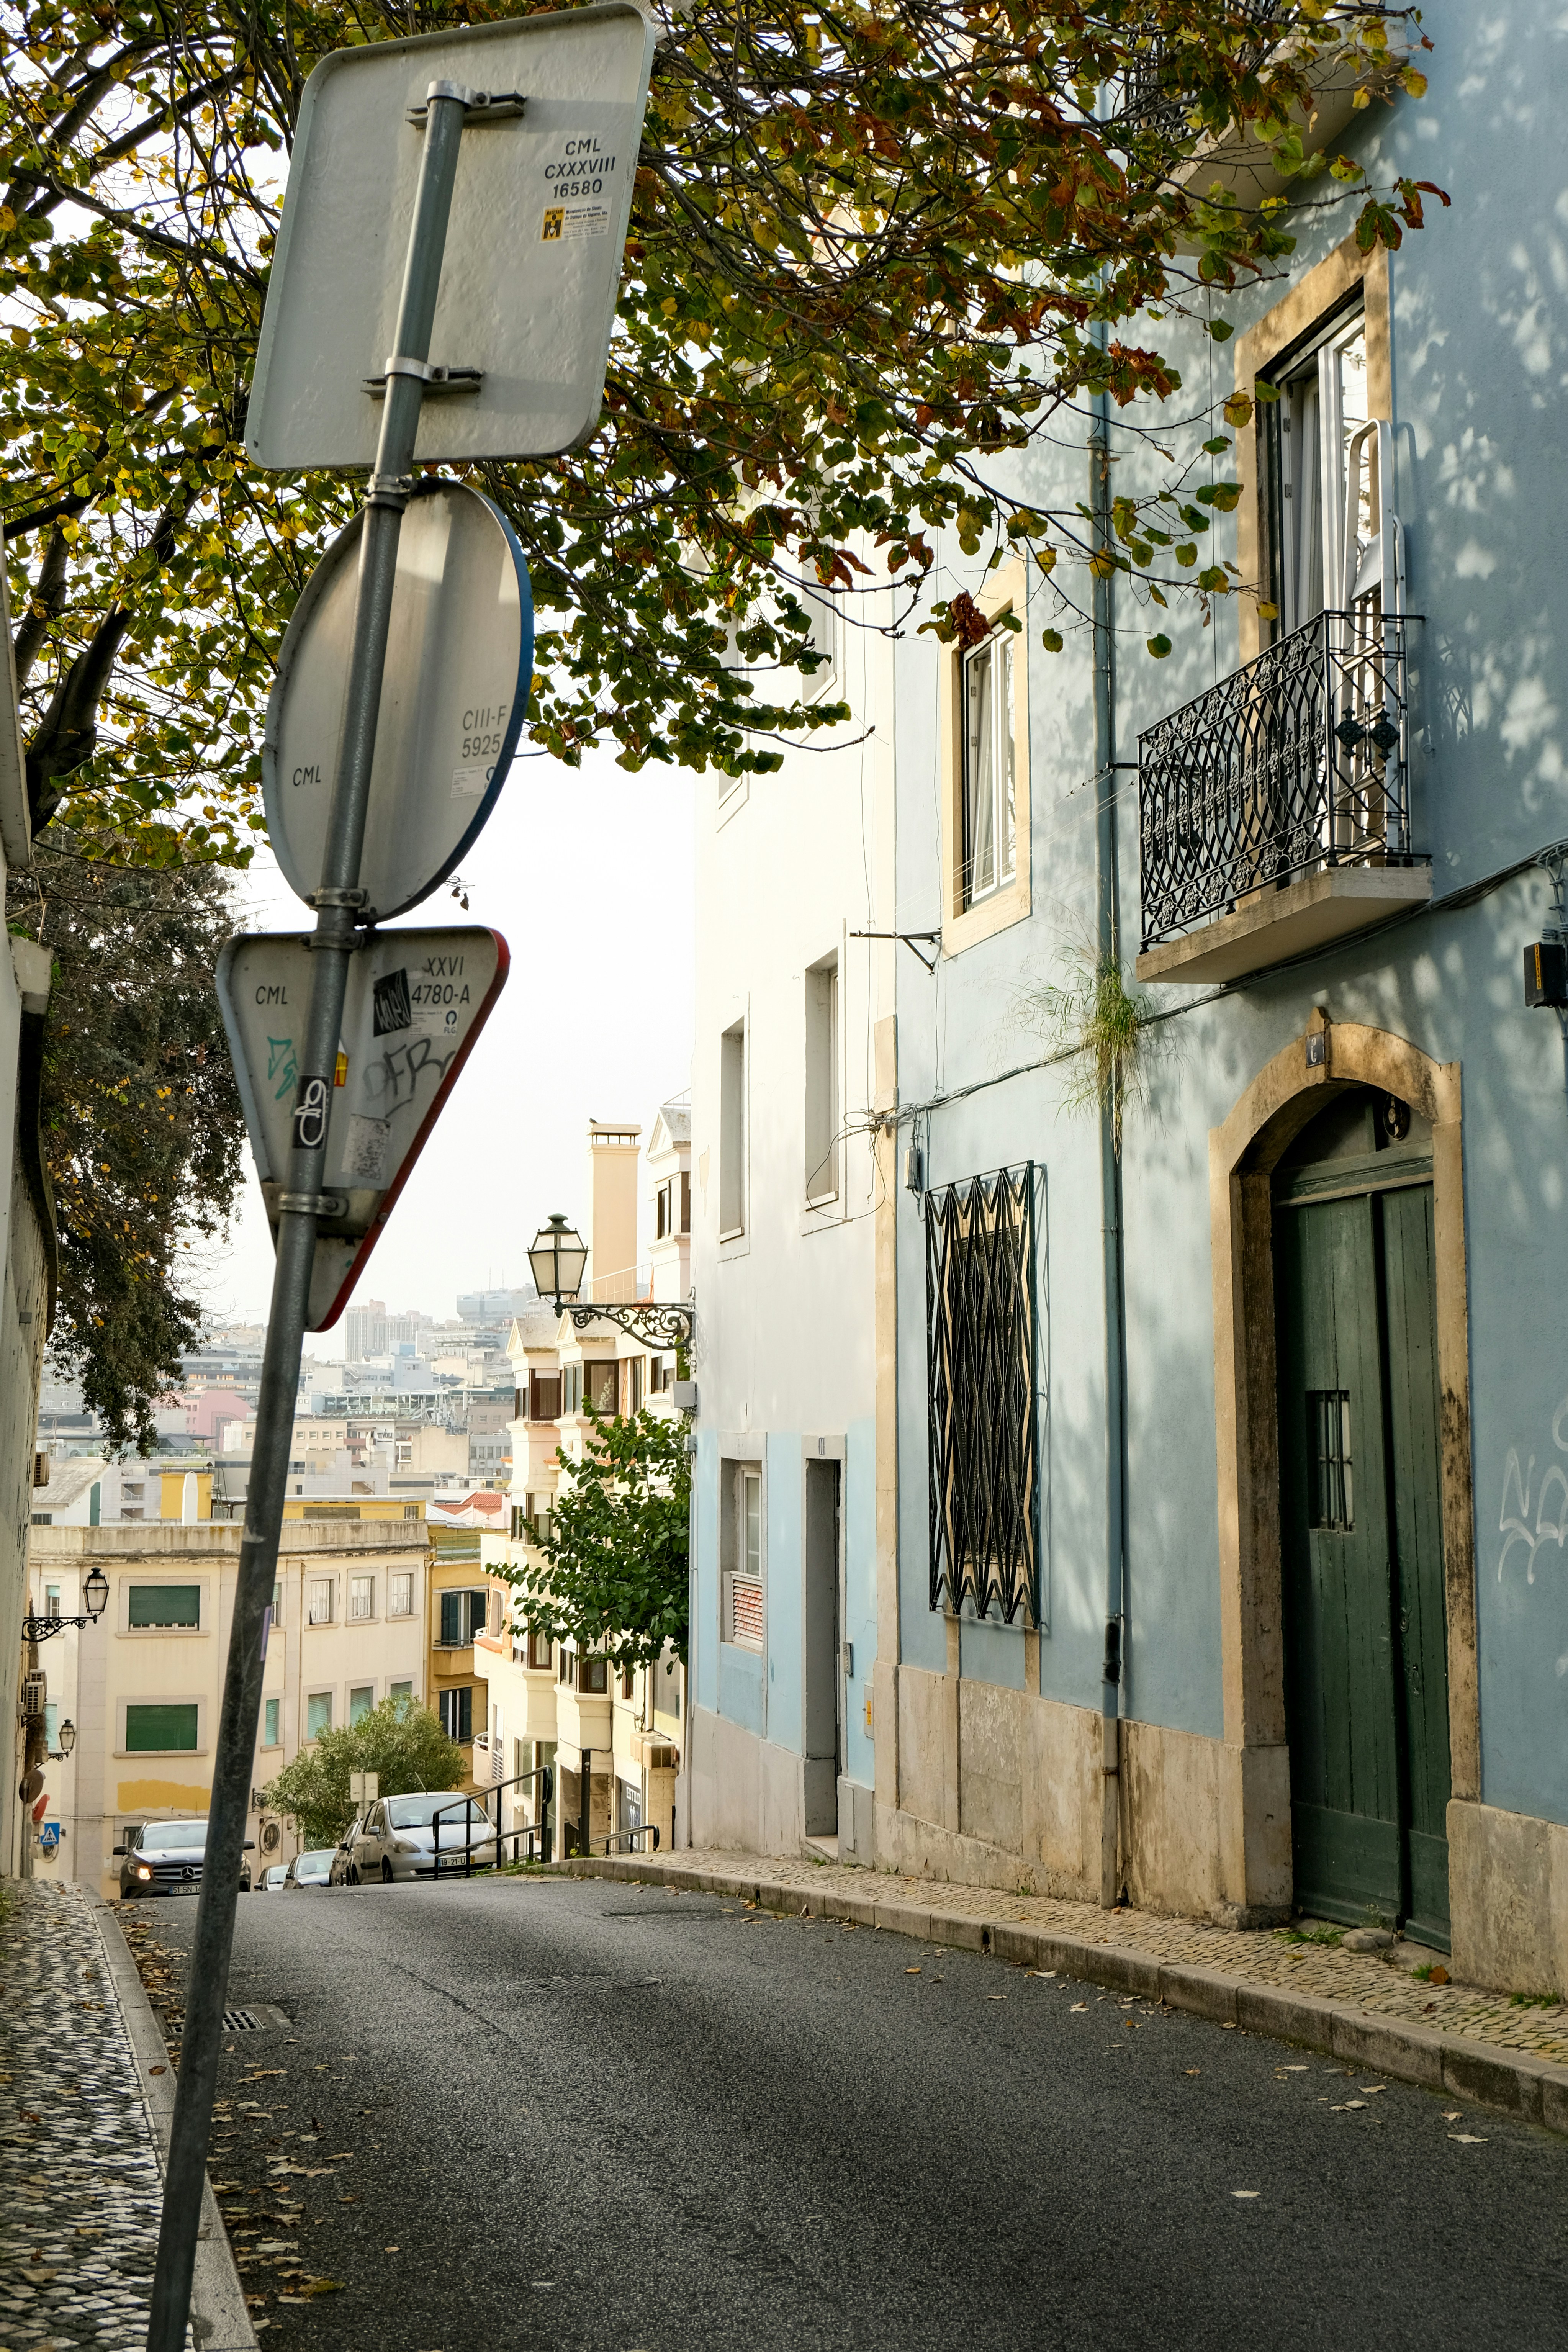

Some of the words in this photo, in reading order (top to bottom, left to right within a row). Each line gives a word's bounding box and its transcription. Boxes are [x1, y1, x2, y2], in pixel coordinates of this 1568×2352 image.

[565, 138, 601, 155] CML
[545, 156, 615, 179] CXXXVIII
[553, 178, 602, 198] 16580
[463, 705, 507, 730] CIII-F
[462, 733, 501, 758] 5925
[293, 765, 321, 786] CML
[427, 956, 464, 976] XXVI
[255, 986, 288, 1004] CML
[411, 984, 470, 1004] 4780-A
[377, 1429, 393, 1439] TIVOLI
